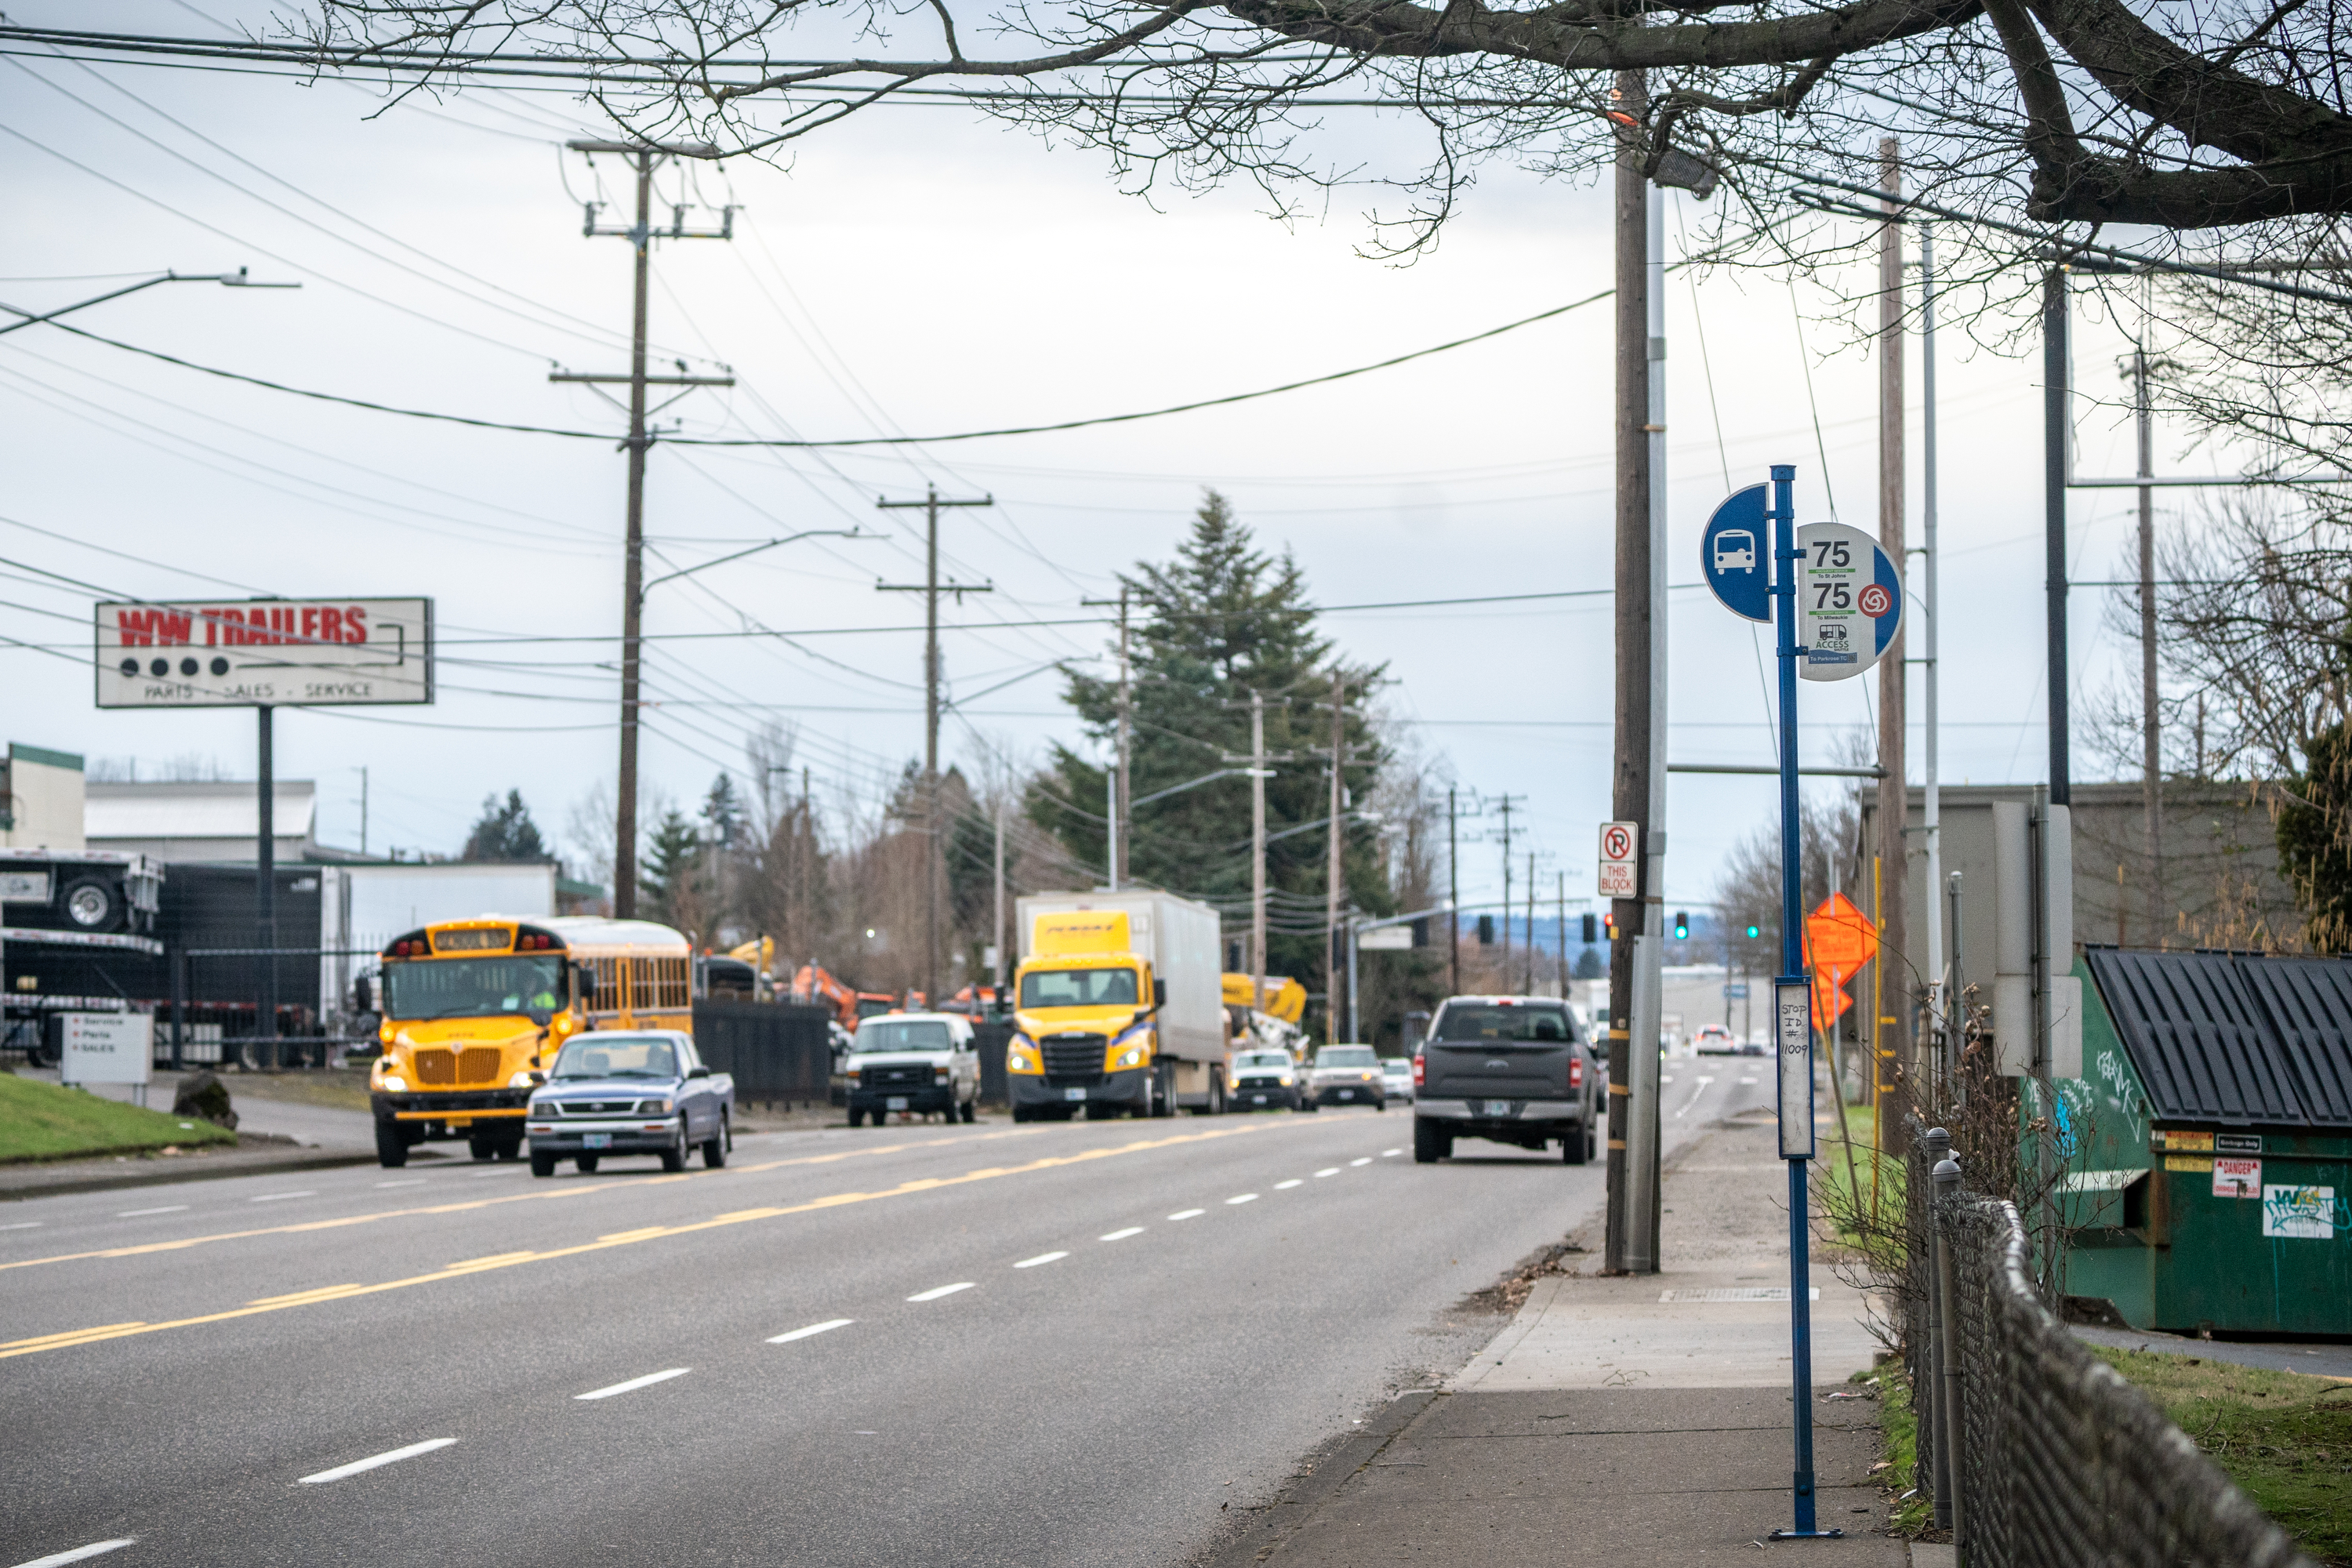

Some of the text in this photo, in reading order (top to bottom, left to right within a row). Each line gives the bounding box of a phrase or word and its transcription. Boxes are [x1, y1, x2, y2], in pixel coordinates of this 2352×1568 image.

[1813, 541, 1850, 568] 75
[1813, 583, 1851, 609] 75
[118, 606, 367, 647] WW TRAILERS
[1816, 641, 1849, 649] ACCESS
[144, 681, 372, 699] PARTS SALES SERVICE
[1607, 866, 1628, 877] THIS
[1602, 878, 1633, 890] BLOCK
[1782, 1004, 1807, 1018] STOP
[1784, 1018, 1802, 1027] ID
[1781, 1043, 1808, 1059] 11009
[2223, 1161, 2252, 1174] DANGER
